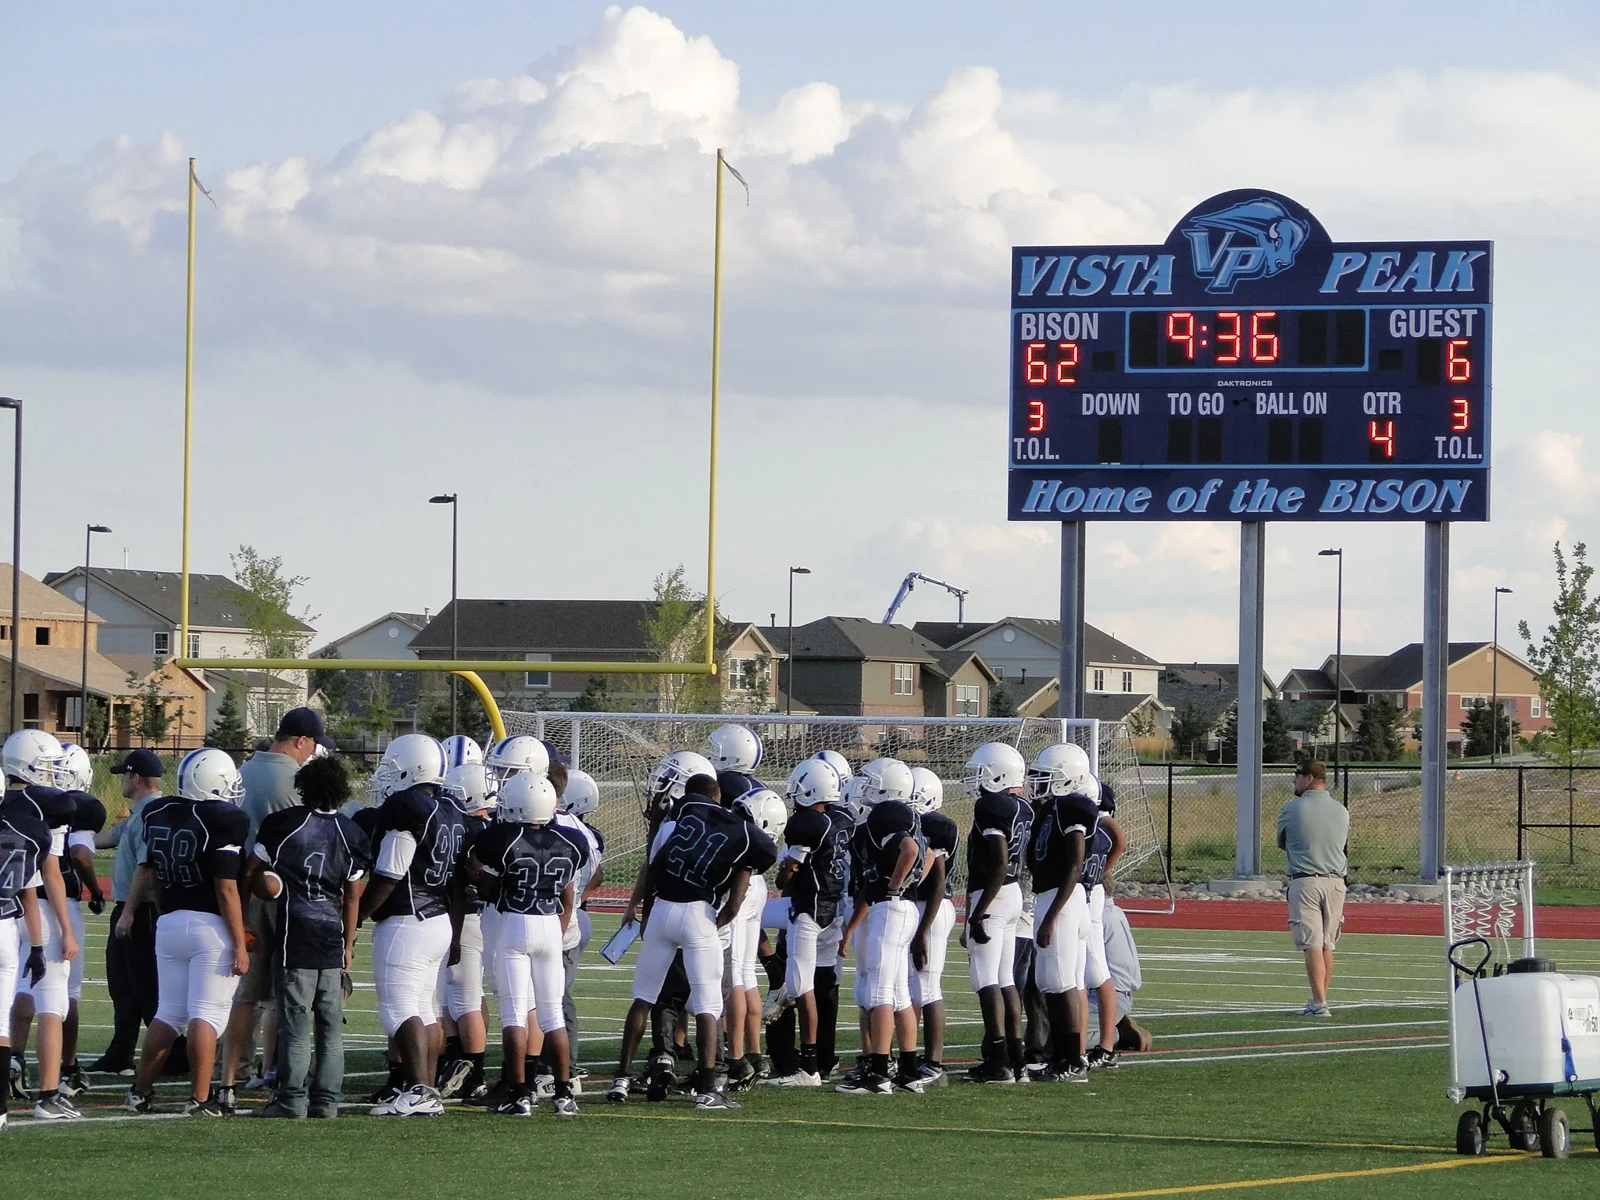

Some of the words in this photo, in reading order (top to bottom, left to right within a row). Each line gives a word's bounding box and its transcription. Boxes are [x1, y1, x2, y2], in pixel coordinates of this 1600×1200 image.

[1017, 254, 1176, 297] VISTA
[1319, 250, 1487, 293] PEAK
[1181, 229, 1266, 294] VP
[1021, 312, 1099, 340] BISON
[1166, 311, 1279, 361] 9:36
[1389, 309, 1478, 338] GUEST
[1026, 342, 1079, 384] 62
[1448, 339, 1471, 382] 6
[1027, 400, 1045, 432] 3
[1082, 392, 1140, 416] DOWN
[1167, 393, 1192, 416] TO
[1198, 392, 1224, 416] GO
[1256, 392, 1298, 415] BALL
[1303, 392, 1327, 415] ON
[1363, 391, 1402, 415] QTR
[1451, 398, 1469, 431] 3
[1013, 437, 1060, 460] T.O.L.
[1369, 420, 1393, 458] 4
[1434, 436, 1483, 459] T.O.L.
[1021, 479, 1153, 514] Home
[1166, 478, 1224, 514] of
[1228, 478, 1306, 514] the
[1318, 478, 1473, 514] BISON
[147, 825, 204, 889] 58
[666, 814, 729, 889] 21
[303, 851, 327, 902] 1
